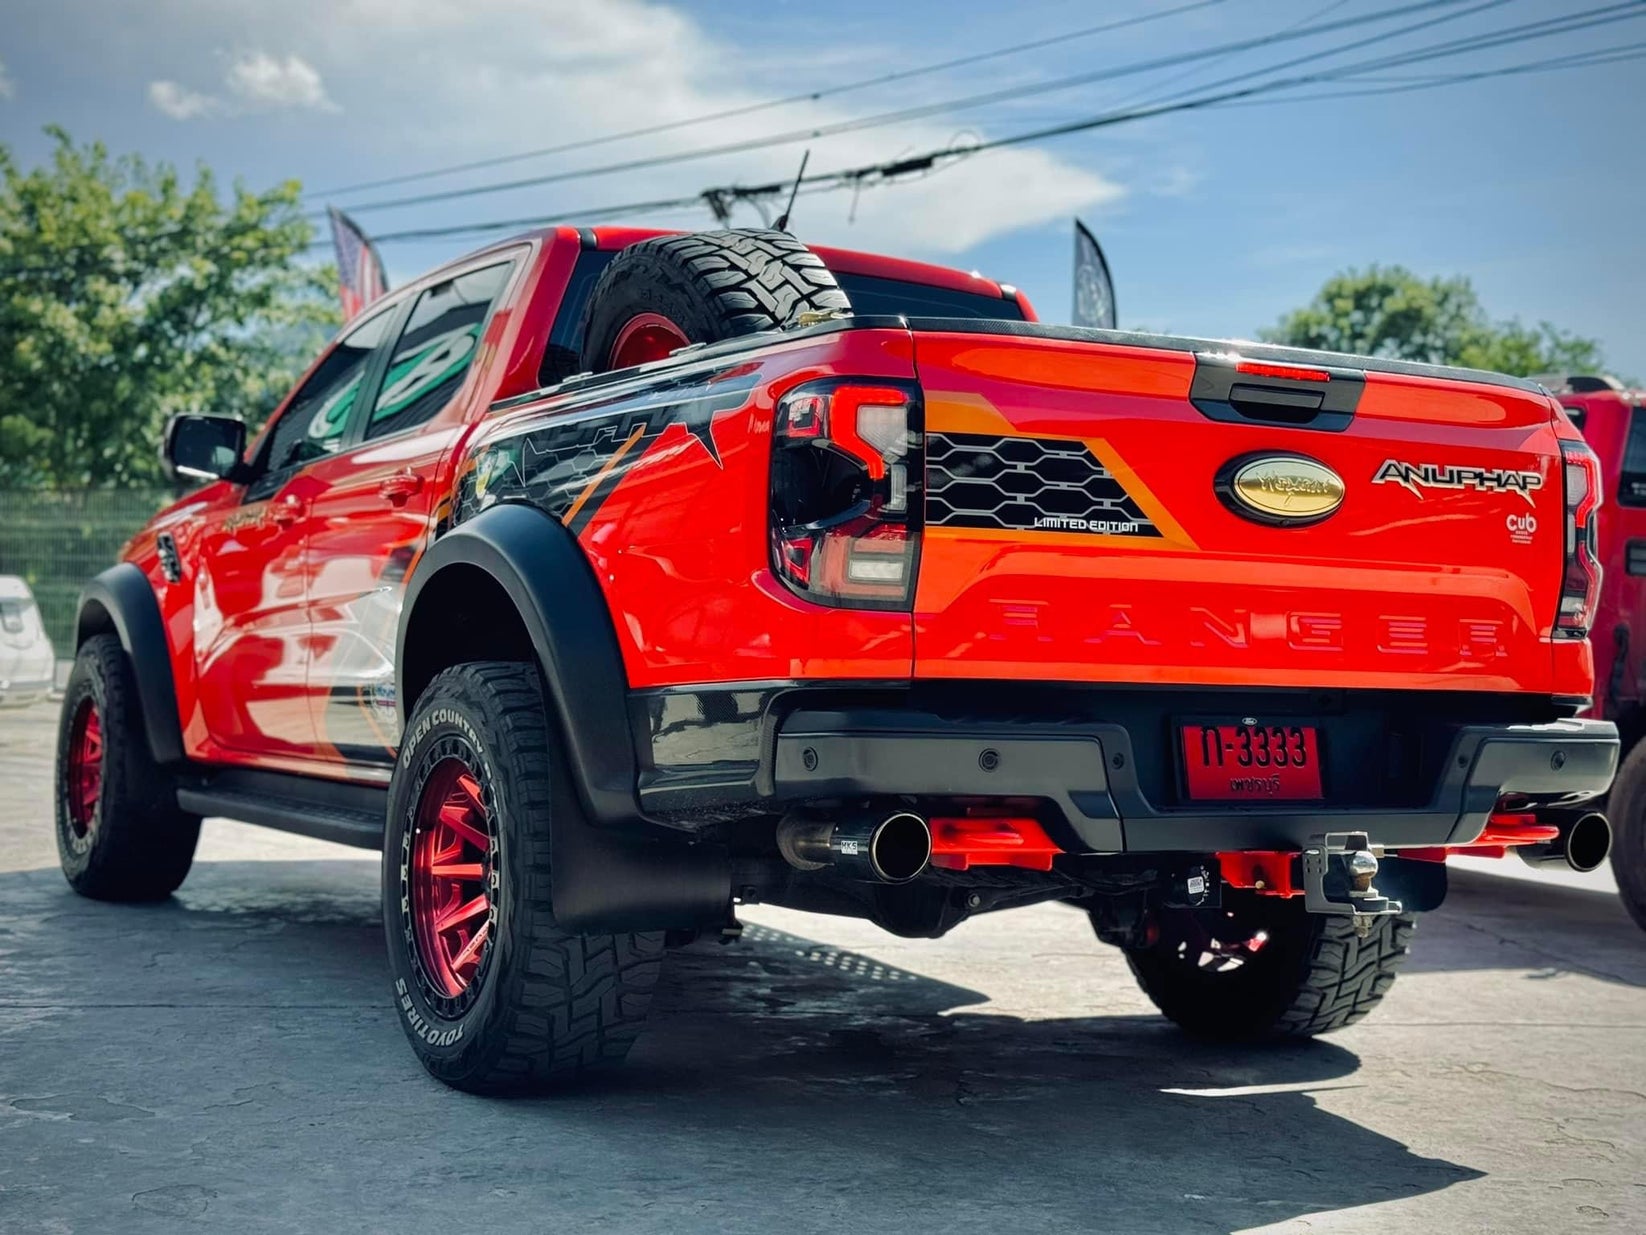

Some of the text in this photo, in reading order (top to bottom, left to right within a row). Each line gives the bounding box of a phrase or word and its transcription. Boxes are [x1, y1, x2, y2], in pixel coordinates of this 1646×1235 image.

[1371, 459, 1543, 508] ANUPHAP
[1034, 517, 1139, 532] LIMITED EDITION
[403, 708, 484, 769] OPEN COUNTRY
[395, 977, 465, 1047] TOYO TIRES
